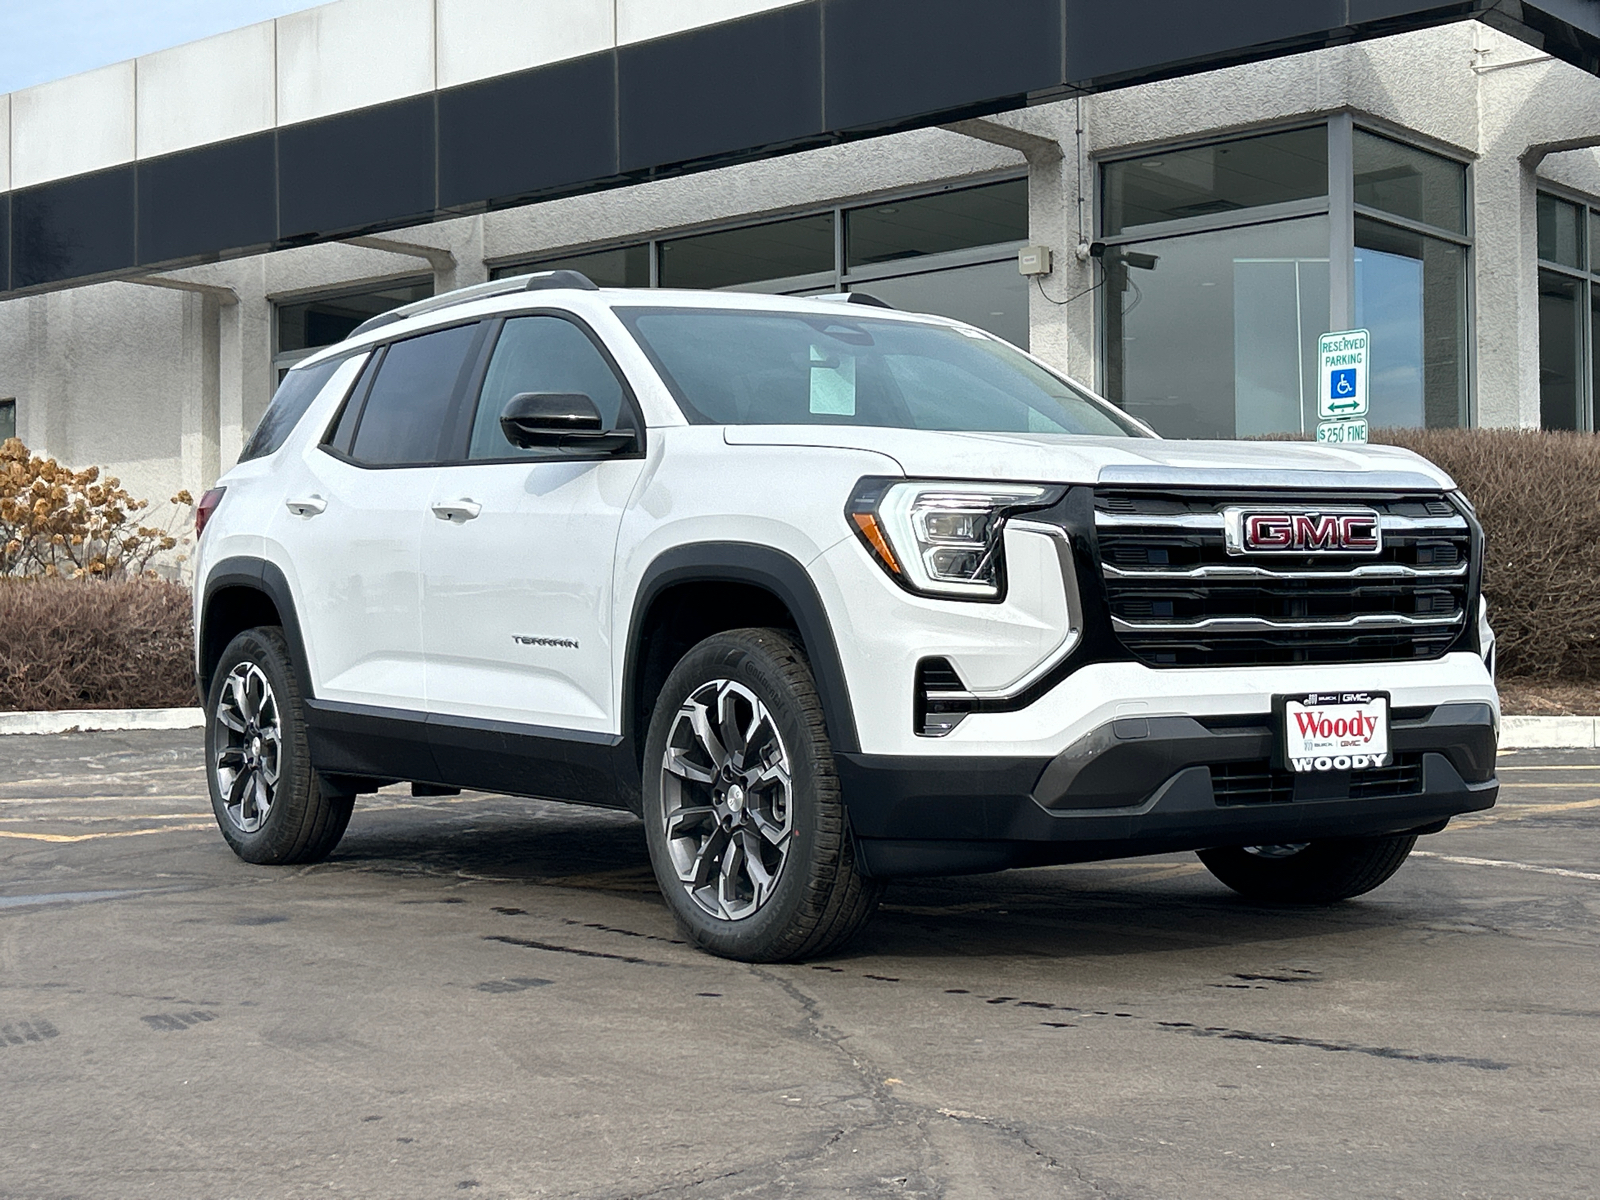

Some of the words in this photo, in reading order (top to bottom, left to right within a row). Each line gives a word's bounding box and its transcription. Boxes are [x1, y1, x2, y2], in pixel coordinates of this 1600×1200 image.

[1322, 338, 1365, 353] RESERVED
[1325, 353, 1362, 367] PARKING
[1347, 425, 1365, 442] FINE
[1246, 515, 1378, 549] GMC
[511, 635, 579, 649] TERRAIN
[1342, 693, 1368, 702] GMC
[1293, 710, 1379, 743] Woody
[1292, 753, 1387, 772] WOODY
